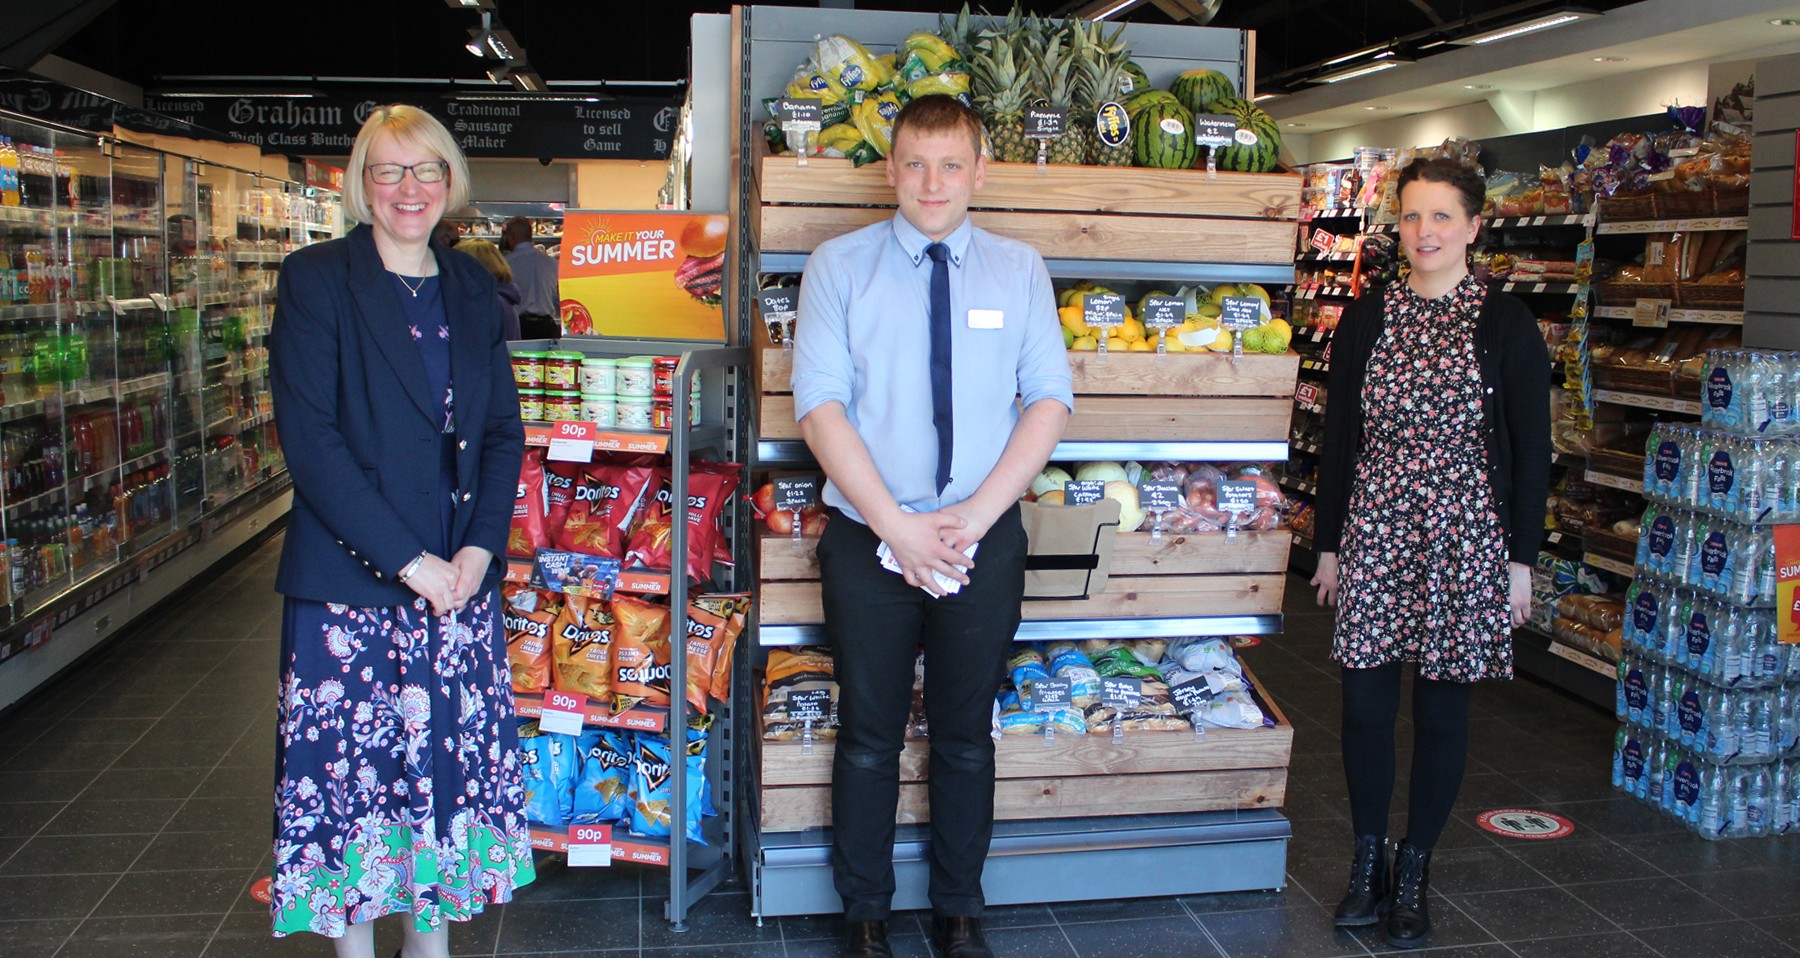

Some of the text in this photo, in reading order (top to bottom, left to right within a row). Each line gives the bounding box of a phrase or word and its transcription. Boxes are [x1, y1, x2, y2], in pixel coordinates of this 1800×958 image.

[841, 66, 862, 88] fyffes
[228, 98, 342, 129] Graham
[447, 102, 521, 117] Traditional
[575, 105, 631, 120] Licensed
[822, 104, 849, 115] remium
[454, 119, 513, 135] Sausage
[583, 123, 622, 136] to sell
[267, 132, 307, 146] Class
[461, 135, 506, 149] Maker
[583, 138, 622, 152] Game
[595, 229, 665, 243] MAKE IT YOUR
[571, 239, 676, 266] SUMMER
[764, 296, 790, 306] Dates
[561, 423, 587, 438] 90p
[525, 436, 548, 444] MMER
[627, 442, 658, 451] SUMMER
[545, 472, 573, 489] itos
[574, 484, 621, 501] Doritos
[538, 554, 570, 563] INSTANT
[544, 561, 567, 569] CASH
[1779, 565, 1800, 579] SUM
[631, 582, 661, 591] SUMMER
[520, 644, 543, 653] CHEESE
[552, 694, 577, 711] 90p
[626, 718, 657, 728] SUMMER
[577, 828, 602, 842] 90p
[632, 851, 662, 862] SUMMER
